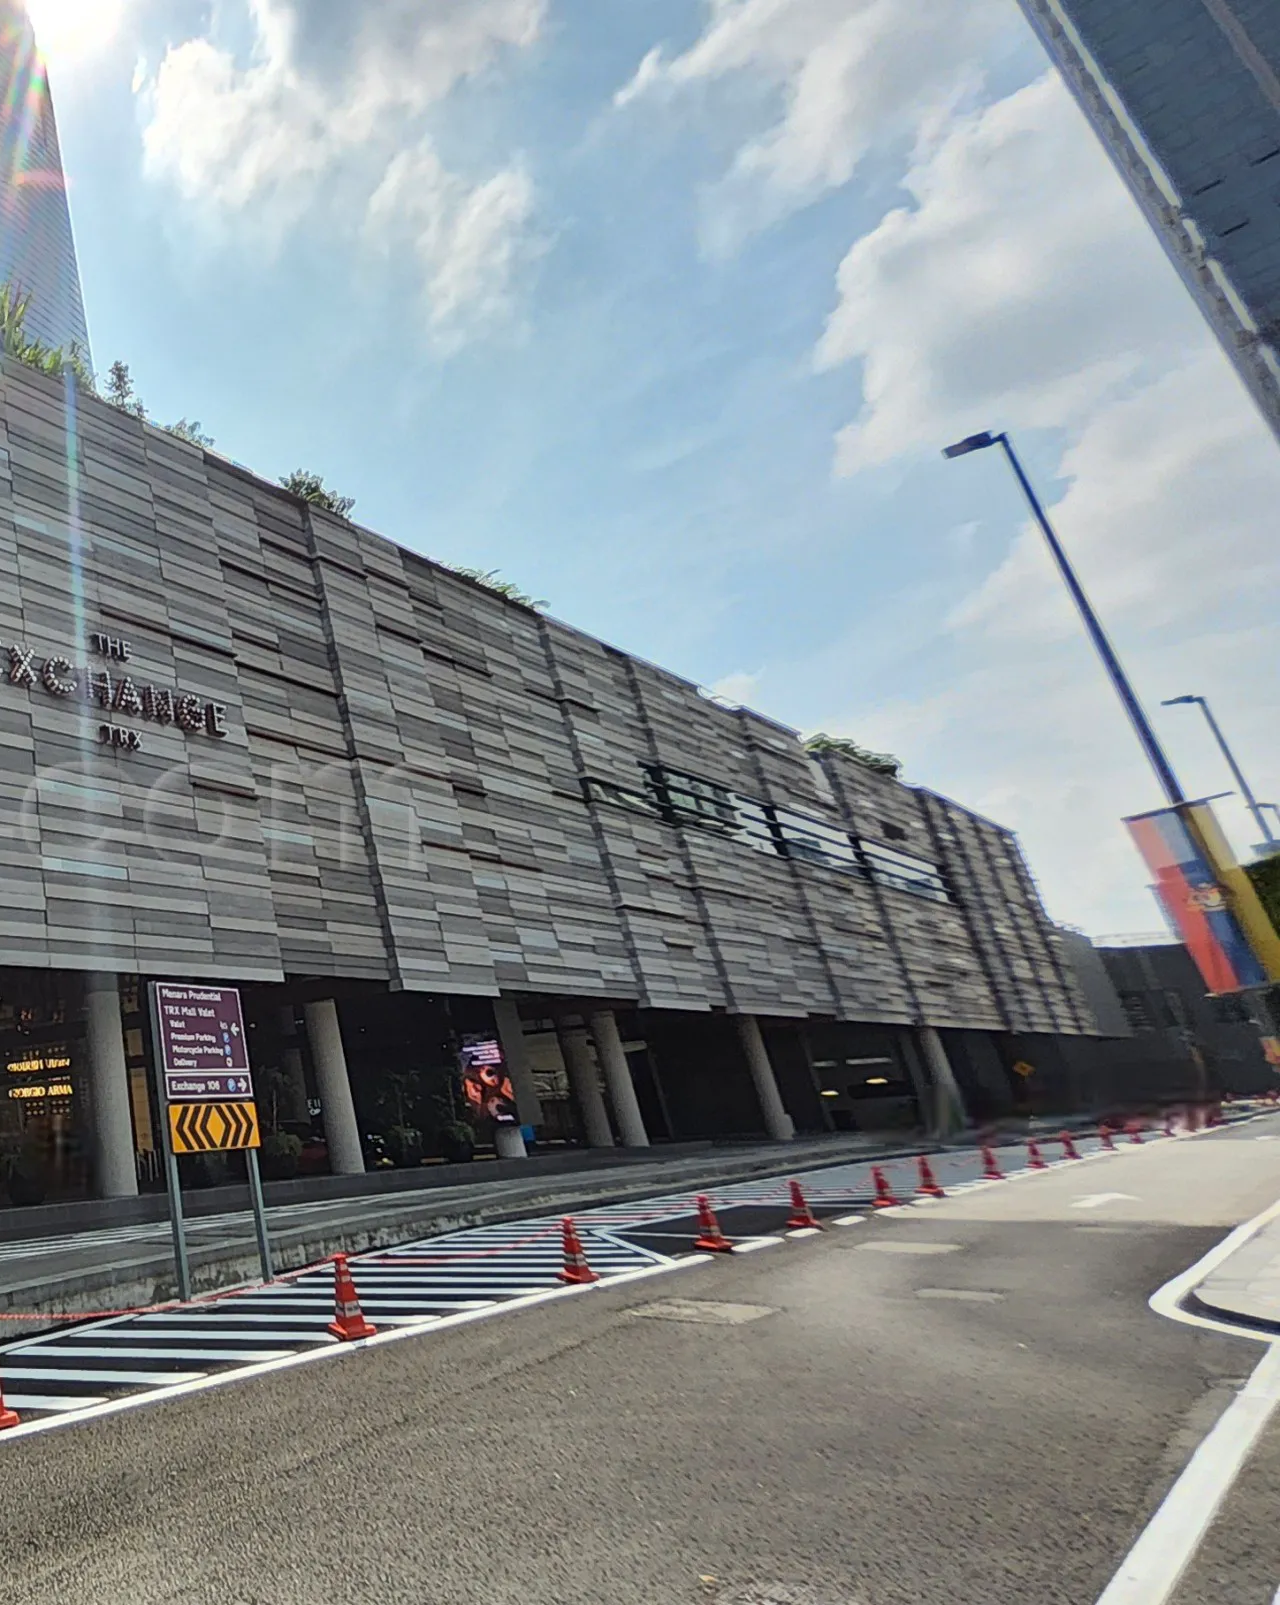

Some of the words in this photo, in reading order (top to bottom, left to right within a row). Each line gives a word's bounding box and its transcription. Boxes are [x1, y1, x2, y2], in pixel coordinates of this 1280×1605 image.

[94, 632, 132, 662] THE
[101, 723, 143, 751] TRX
[162, 989, 187, 999] Menara
[188, 990, 221, 1001] Prudential
[164, 1004, 180, 1015] TRX
[181, 1006, 197, 1016] Mall
[198, 1008, 215, 1017] Valet
[170, 1020, 185, 1028] Valet
[196, 1033, 216, 1043] Parking
[172, 1081, 205, 1092] Exchange
